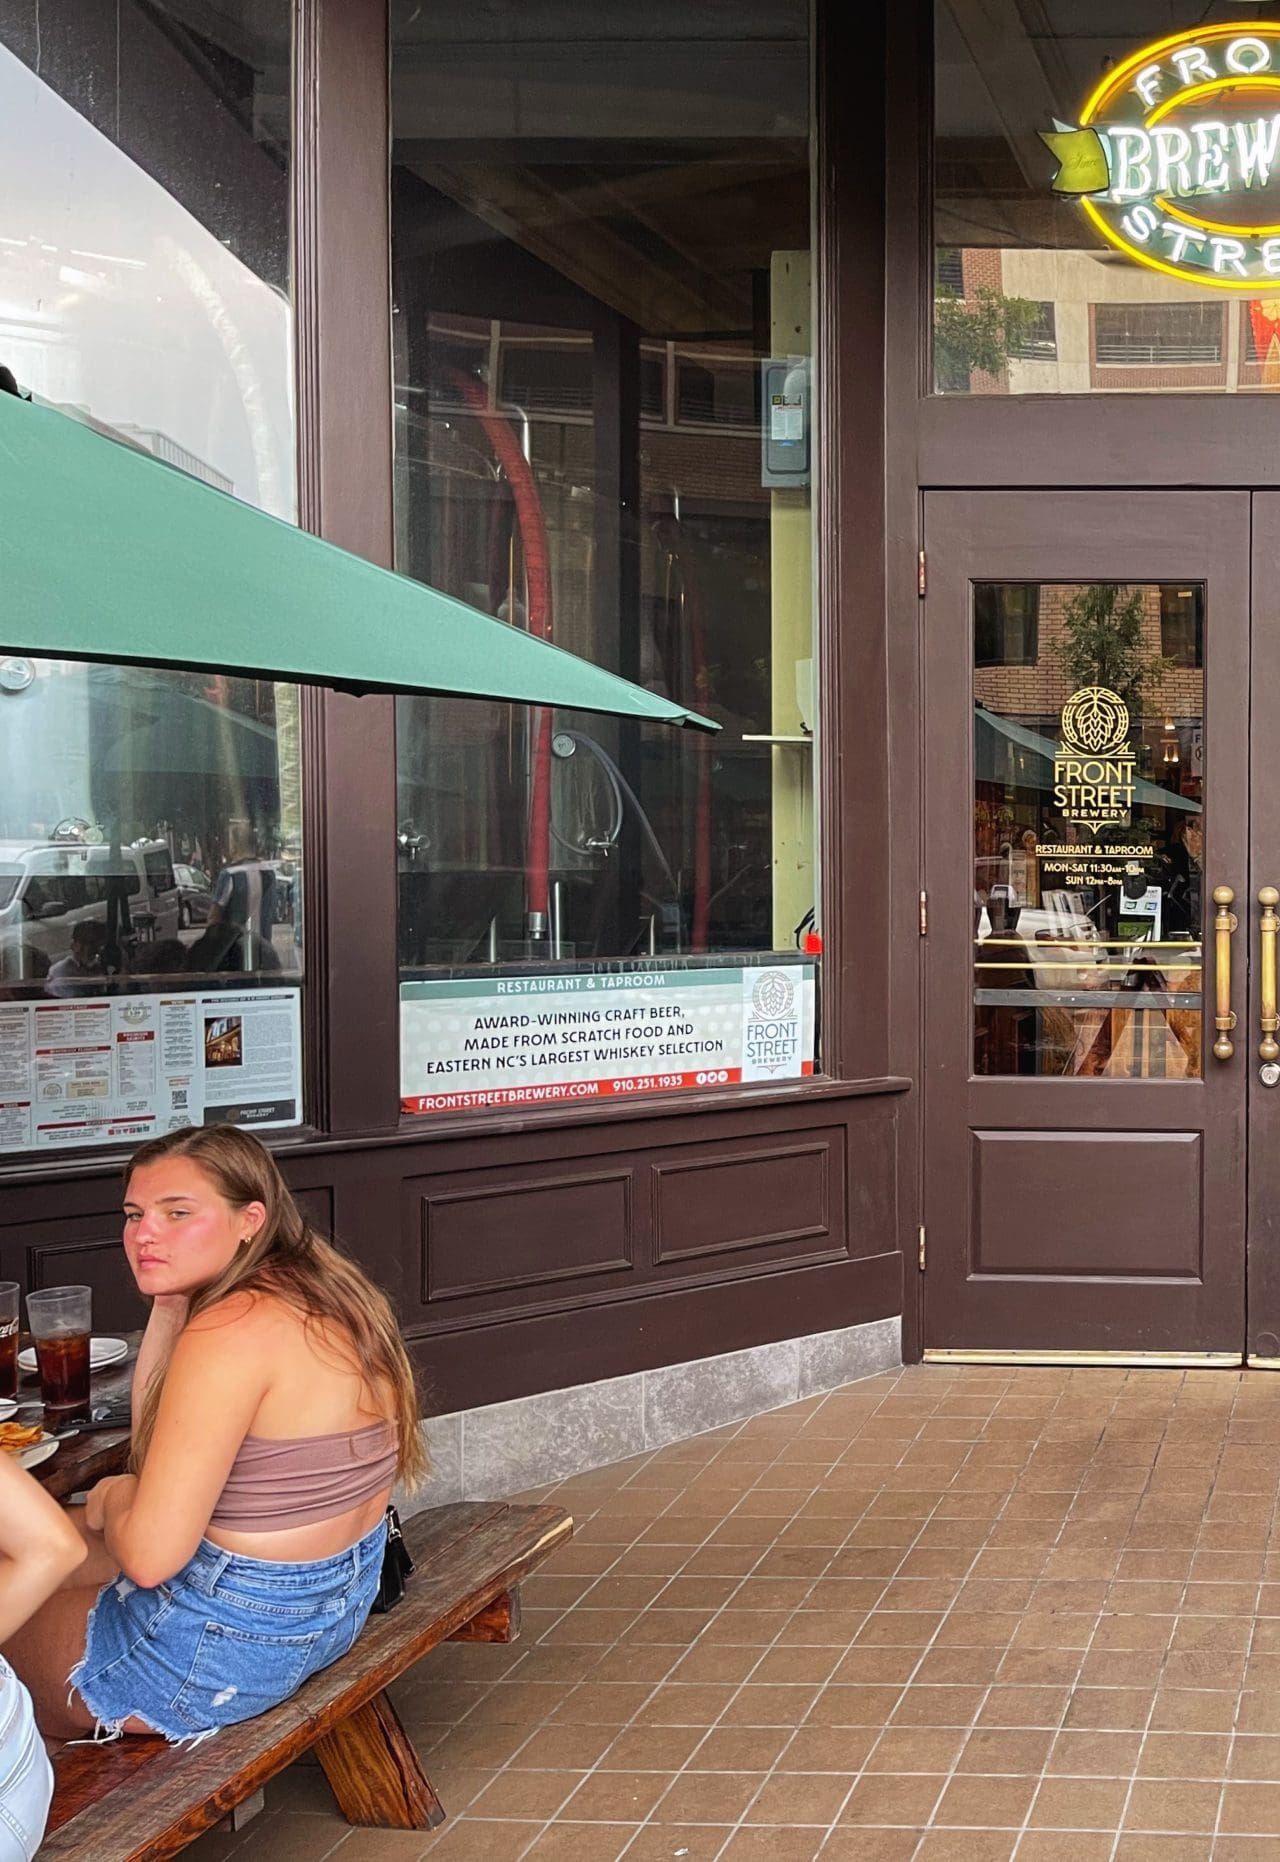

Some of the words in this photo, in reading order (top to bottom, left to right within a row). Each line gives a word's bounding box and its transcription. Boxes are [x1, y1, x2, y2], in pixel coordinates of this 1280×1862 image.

[1054, 761, 1136, 784] FRONT
[1053, 786, 1136, 808] STREET
[1062, 809, 1128, 818] BREWERY
[1036, 845, 1093, 854] RESTAURANT
[1095, 846, 1102, 854] &
[1104, 846, 1154, 855] TAPROOM
[1044, 863, 1088, 872] MON-SAT
[1065, 876, 1084, 885] SUN
[497, 978, 582, 993] RESTAURANT
[586, 977, 596, 989] &
[601, 975, 665, 988] TAPROOM
[474, 1010, 600, 1030] AWARD-WINNING
[605, 1008, 645, 1021] CRAFT
[650, 1006, 685, 1020] BEER,
[464, 1036, 509, 1051] MADE
[514, 1033, 557, 1048] FROM
[562, 1029, 620, 1044] SCRATCH
[626, 1026, 663, 1040] FOOD
[667, 1024, 694, 1036] AND
[747, 1022, 798, 1041] FRONT
[427, 1057, 490, 1074] EASTERN
[496, 1055, 527, 1069] NC'S
[531, 1050, 590, 1066] LARGEST
[594, 1045, 655, 1061] WHISKEY
[659, 1040, 723, 1055] SELECTION
[747, 1039, 798, 1058] STREET
[751, 1056, 792, 1065] BREWERY
[418, 1083, 599, 1110] FRONTSTREETBREWERY.COM
[613, 1075, 683, 1092] 910.251.1935
